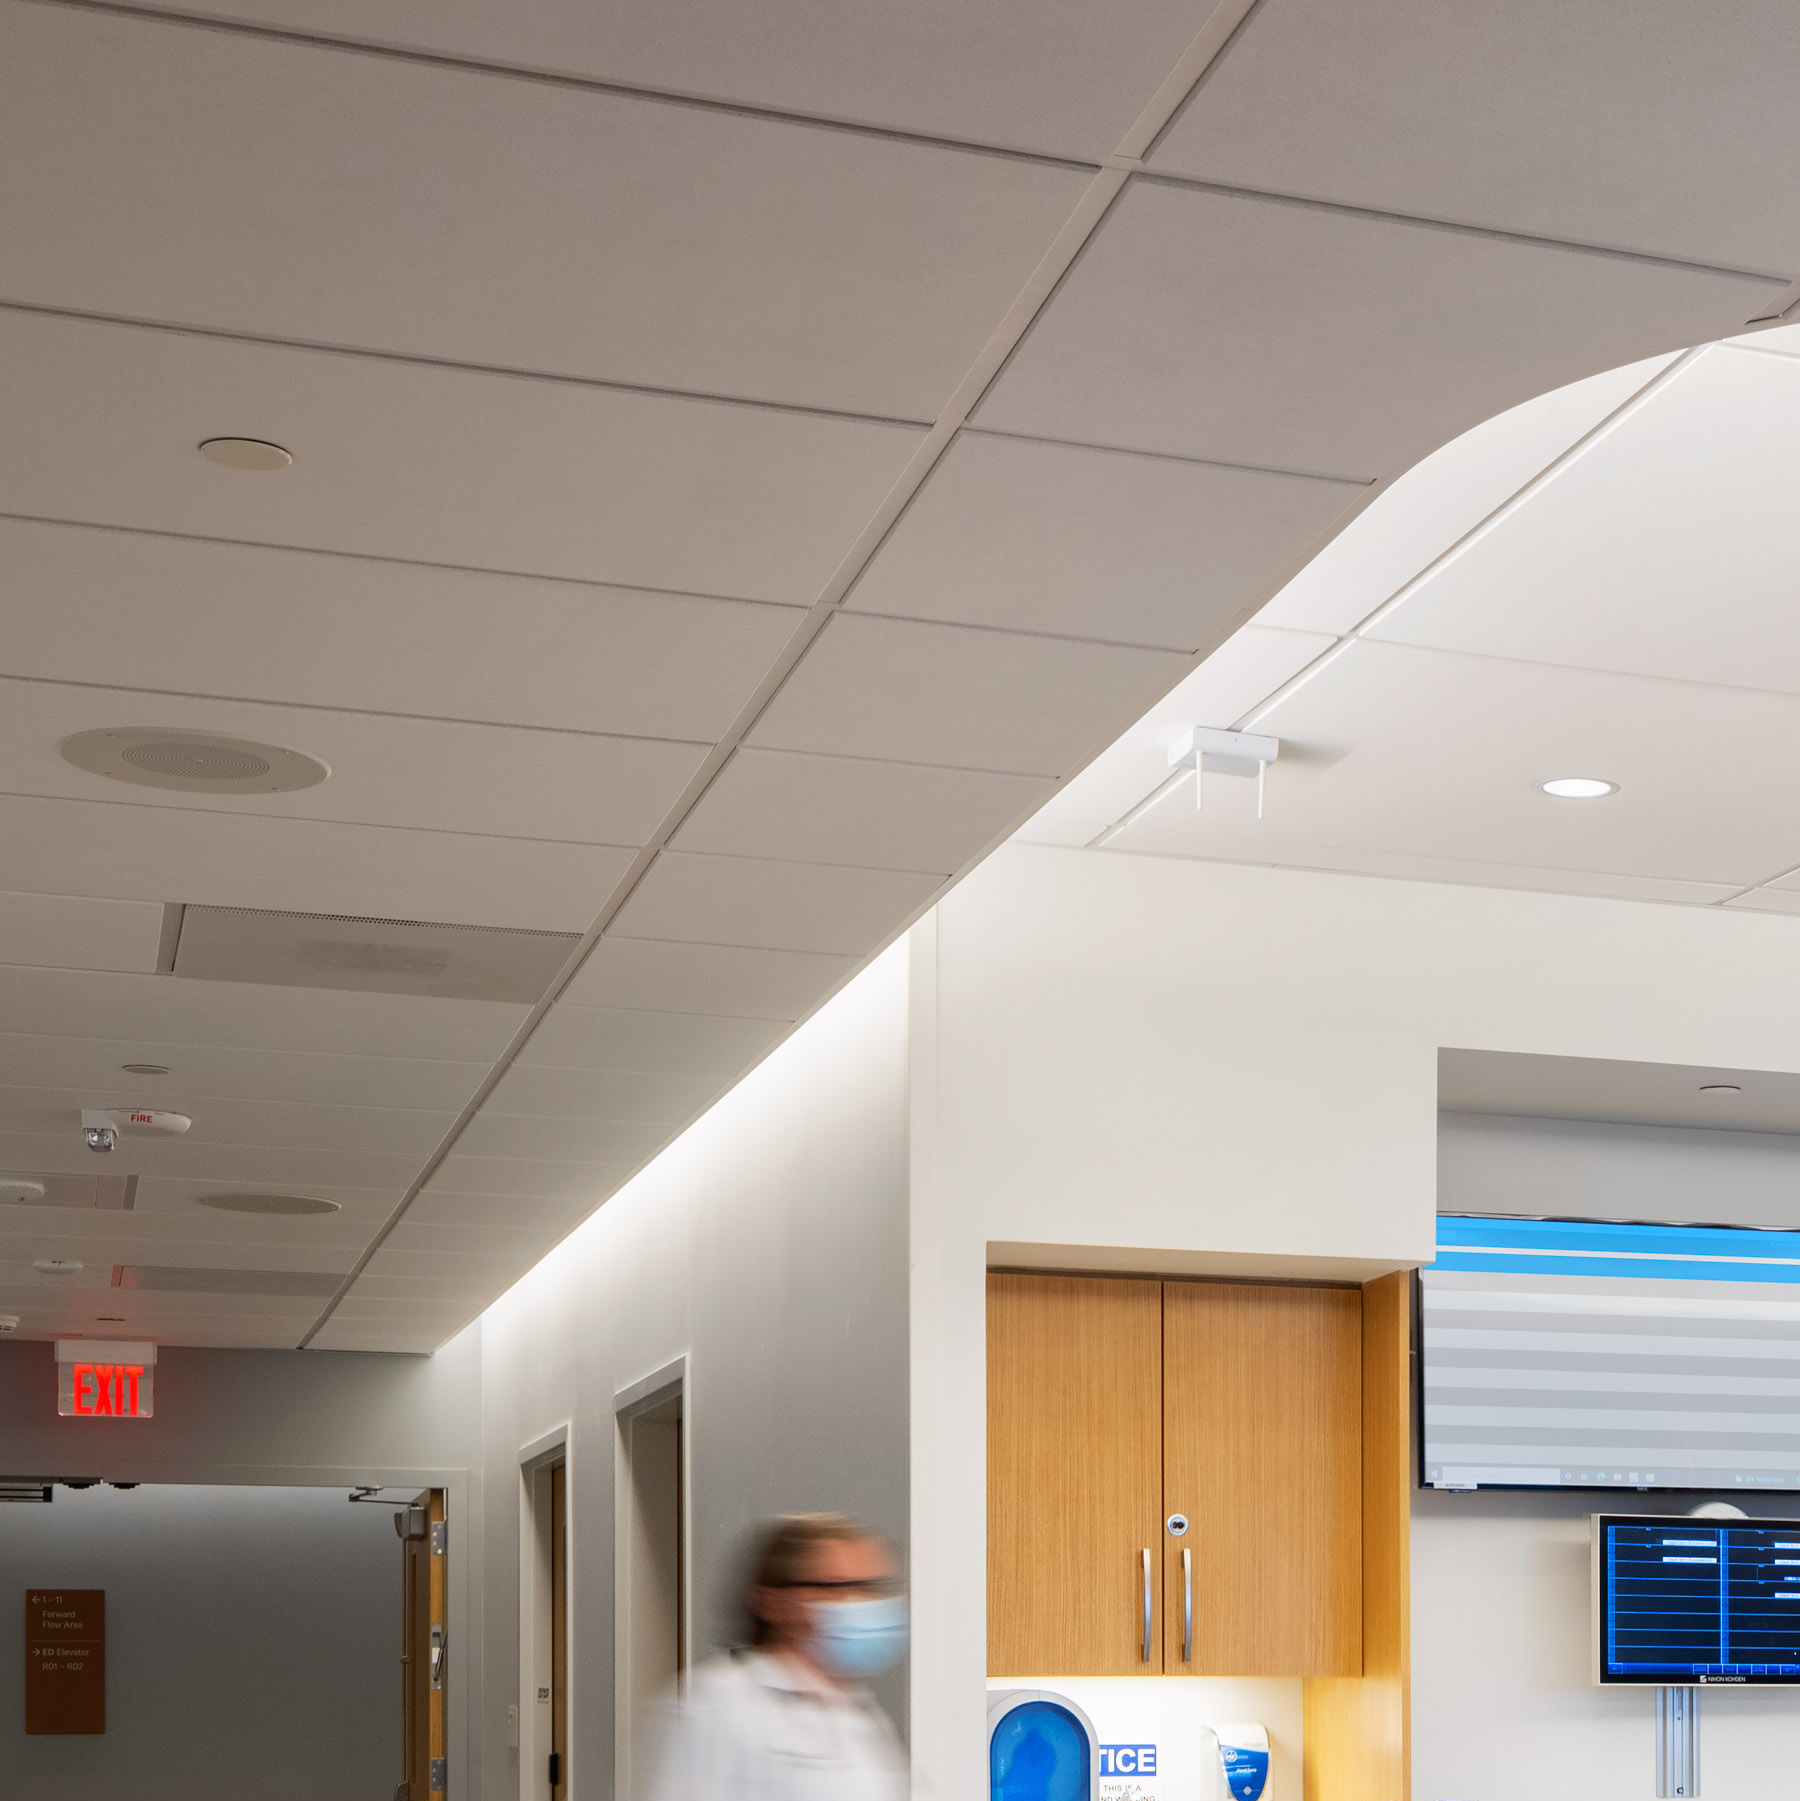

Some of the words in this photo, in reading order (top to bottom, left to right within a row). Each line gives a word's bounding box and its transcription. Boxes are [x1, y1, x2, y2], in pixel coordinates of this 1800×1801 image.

[73, 1363, 144, 1416] EXIT
[42, 1610, 76, 1619] Forward
[42, 1621, 62, 1629] Flow
[63, 1621, 83, 1629] Area
[42, 1648, 55, 1656] ED
[56, 1648, 90, 1656] Elevator
[42, 1662, 58, 1671] R01
[66, 1662, 84, 1671] R02
[1099, 1748, 1156, 1773] TICE
[1104, 1784, 1122, 1792] THIS
[1135, 1784, 1142, 1792] A
